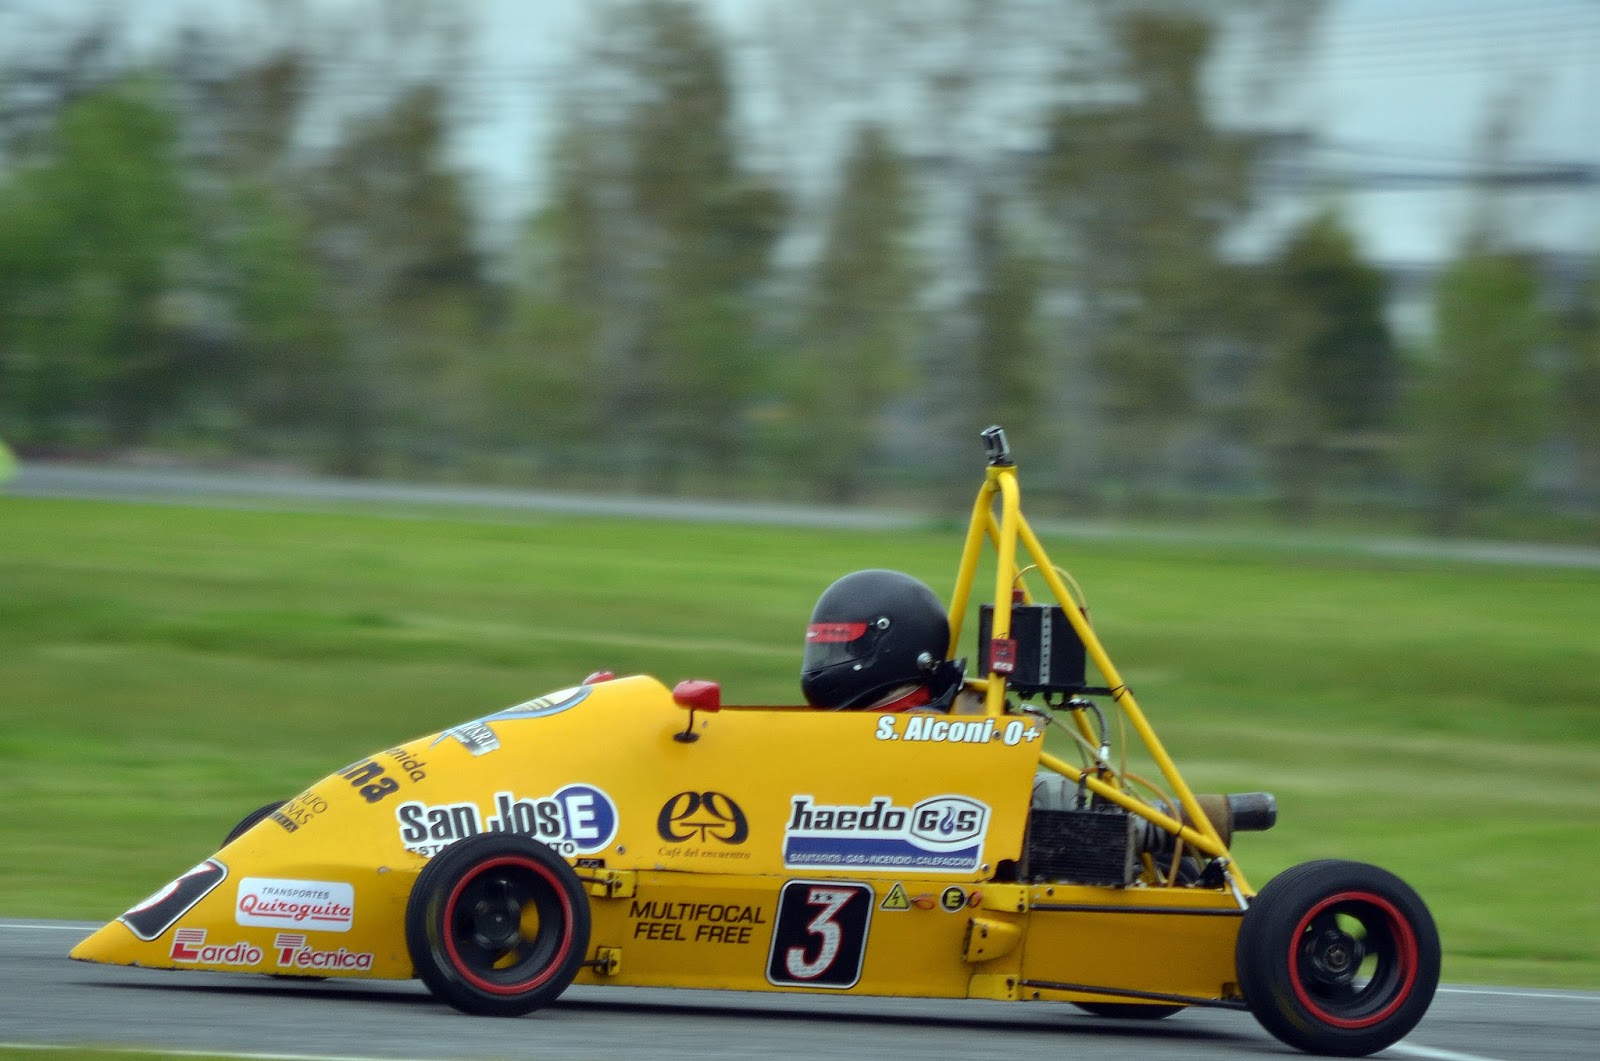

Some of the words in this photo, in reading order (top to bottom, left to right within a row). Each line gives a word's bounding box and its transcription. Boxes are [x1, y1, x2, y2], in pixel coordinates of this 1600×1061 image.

[876, 715, 899, 740] S.
[903, 715, 994, 743] Alconi
[388, 748, 427, 783] nida
[399, 804, 478, 843] San
[788, 801, 905, 831] haedo
[239, 894, 351, 921] Quiroguita
[262, 887, 330, 900] TRANSPORTES
[629, 901, 766, 924] MULTIFOCAL
[633, 922, 686, 941] FEEL
[695, 925, 753, 944] FREE
[786, 887, 857, 979] 3
[276, 934, 372, 967] Técnica
